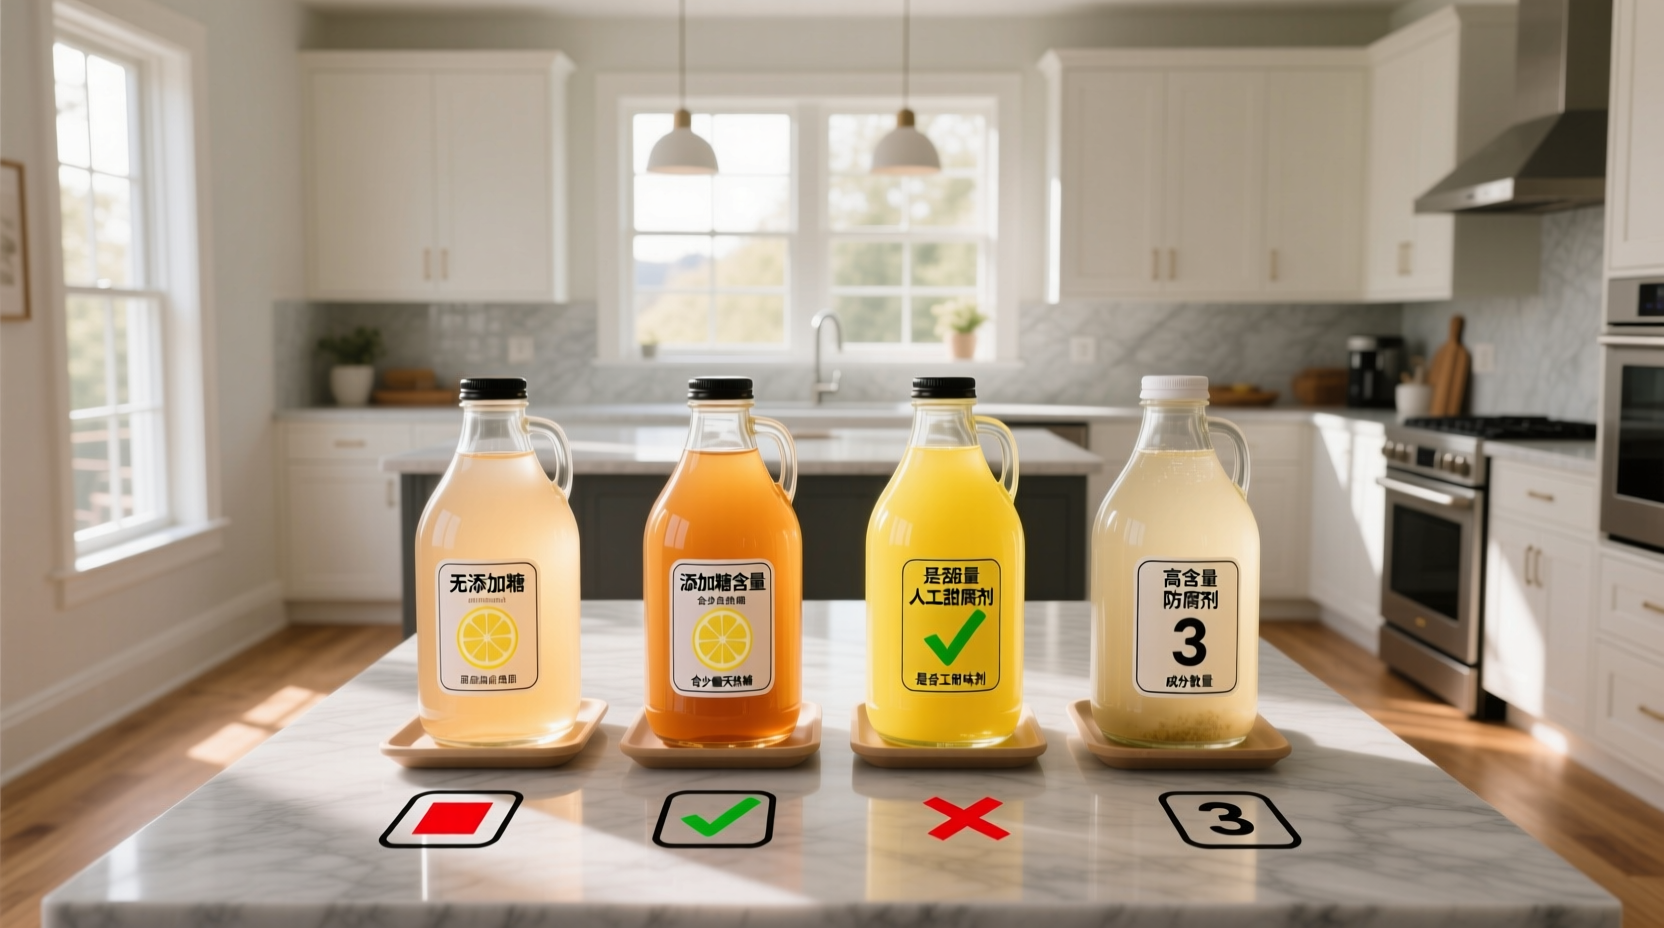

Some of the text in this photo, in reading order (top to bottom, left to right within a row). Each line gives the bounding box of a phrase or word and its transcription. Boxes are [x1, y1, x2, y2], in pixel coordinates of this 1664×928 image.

[449, 572, 525, 594] 无添加糖
[680, 571, 766, 592] 添加糖含量
[1163, 568, 1218, 588] 高含量
[1163, 589, 1219, 610] 防腐剂
[1172, 617, 1207, 667] 3
[1198, 801, 1255, 836] 3
